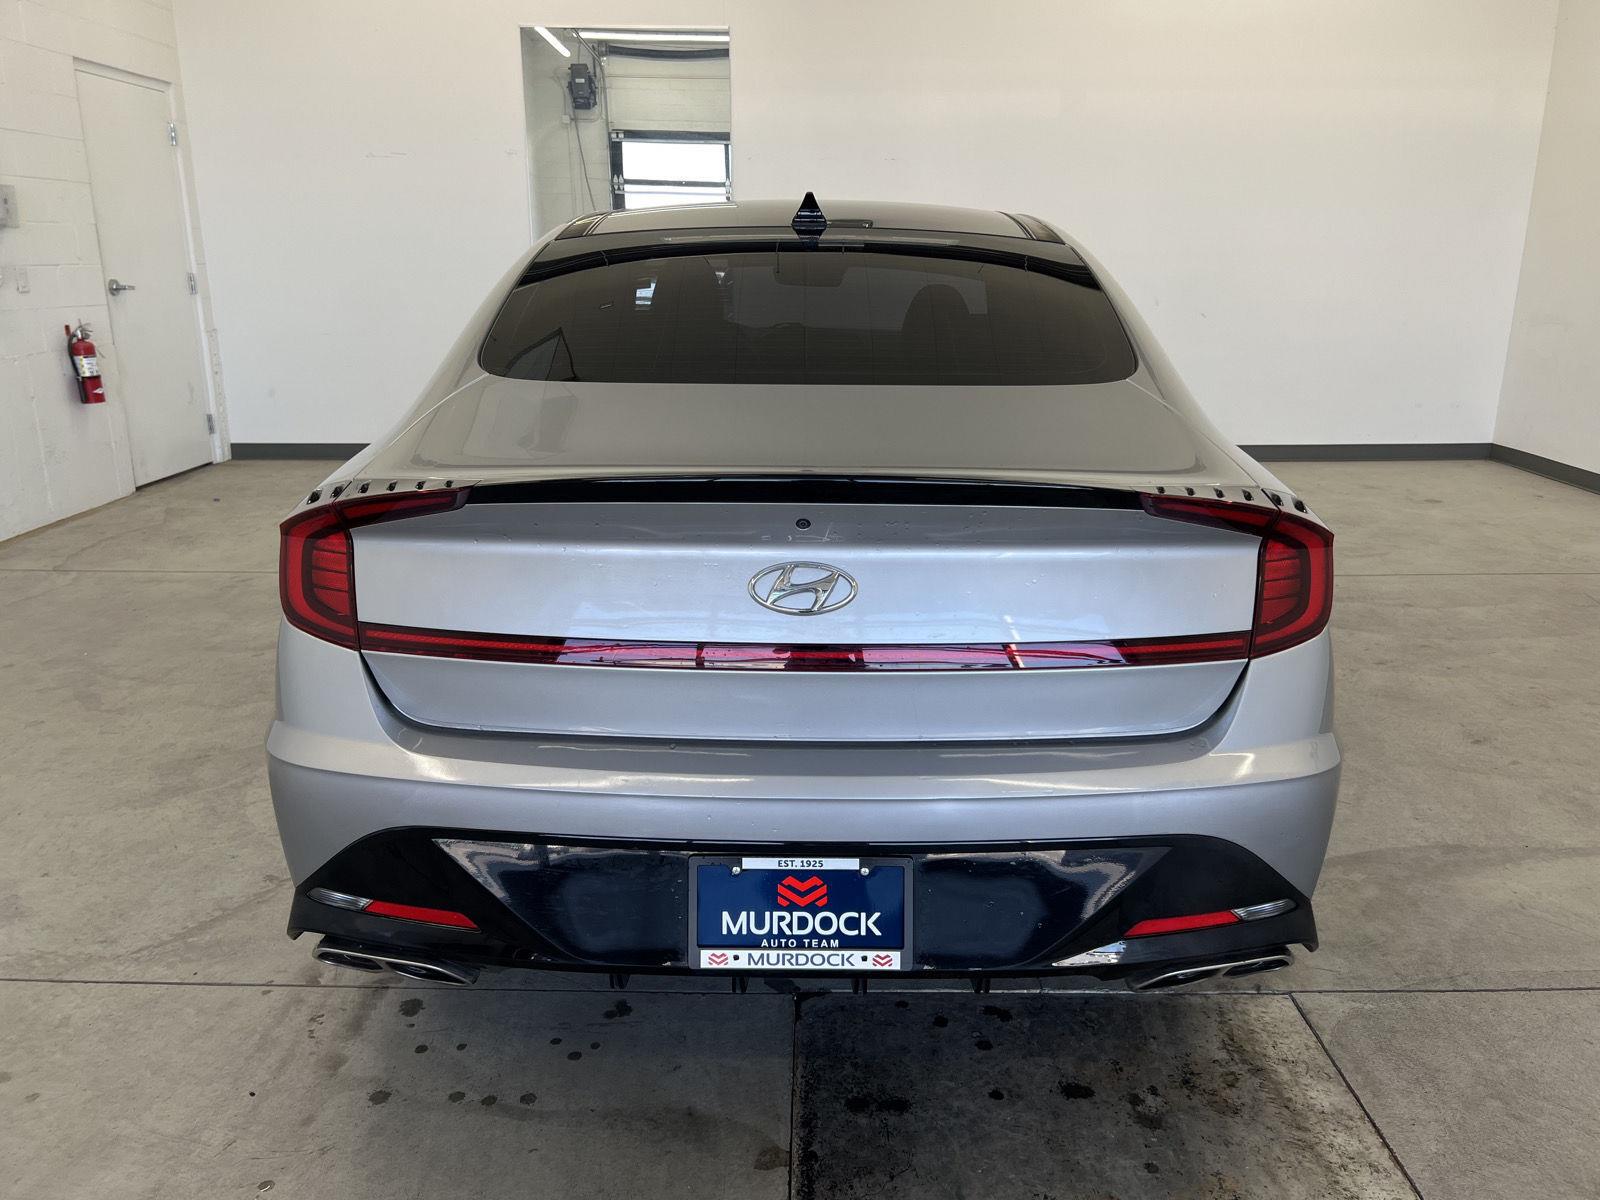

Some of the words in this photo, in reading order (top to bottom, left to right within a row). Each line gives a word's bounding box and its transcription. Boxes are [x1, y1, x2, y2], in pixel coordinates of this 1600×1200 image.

[777, 859, 798, 868] EST.
[800, 859, 824, 868] 1925
[721, 910, 882, 936] MURDOCK
[760, 939, 797, 948] AUTO
[803, 939, 840, 948] TEAM
[747, 952, 856, 967] MURDOCK
